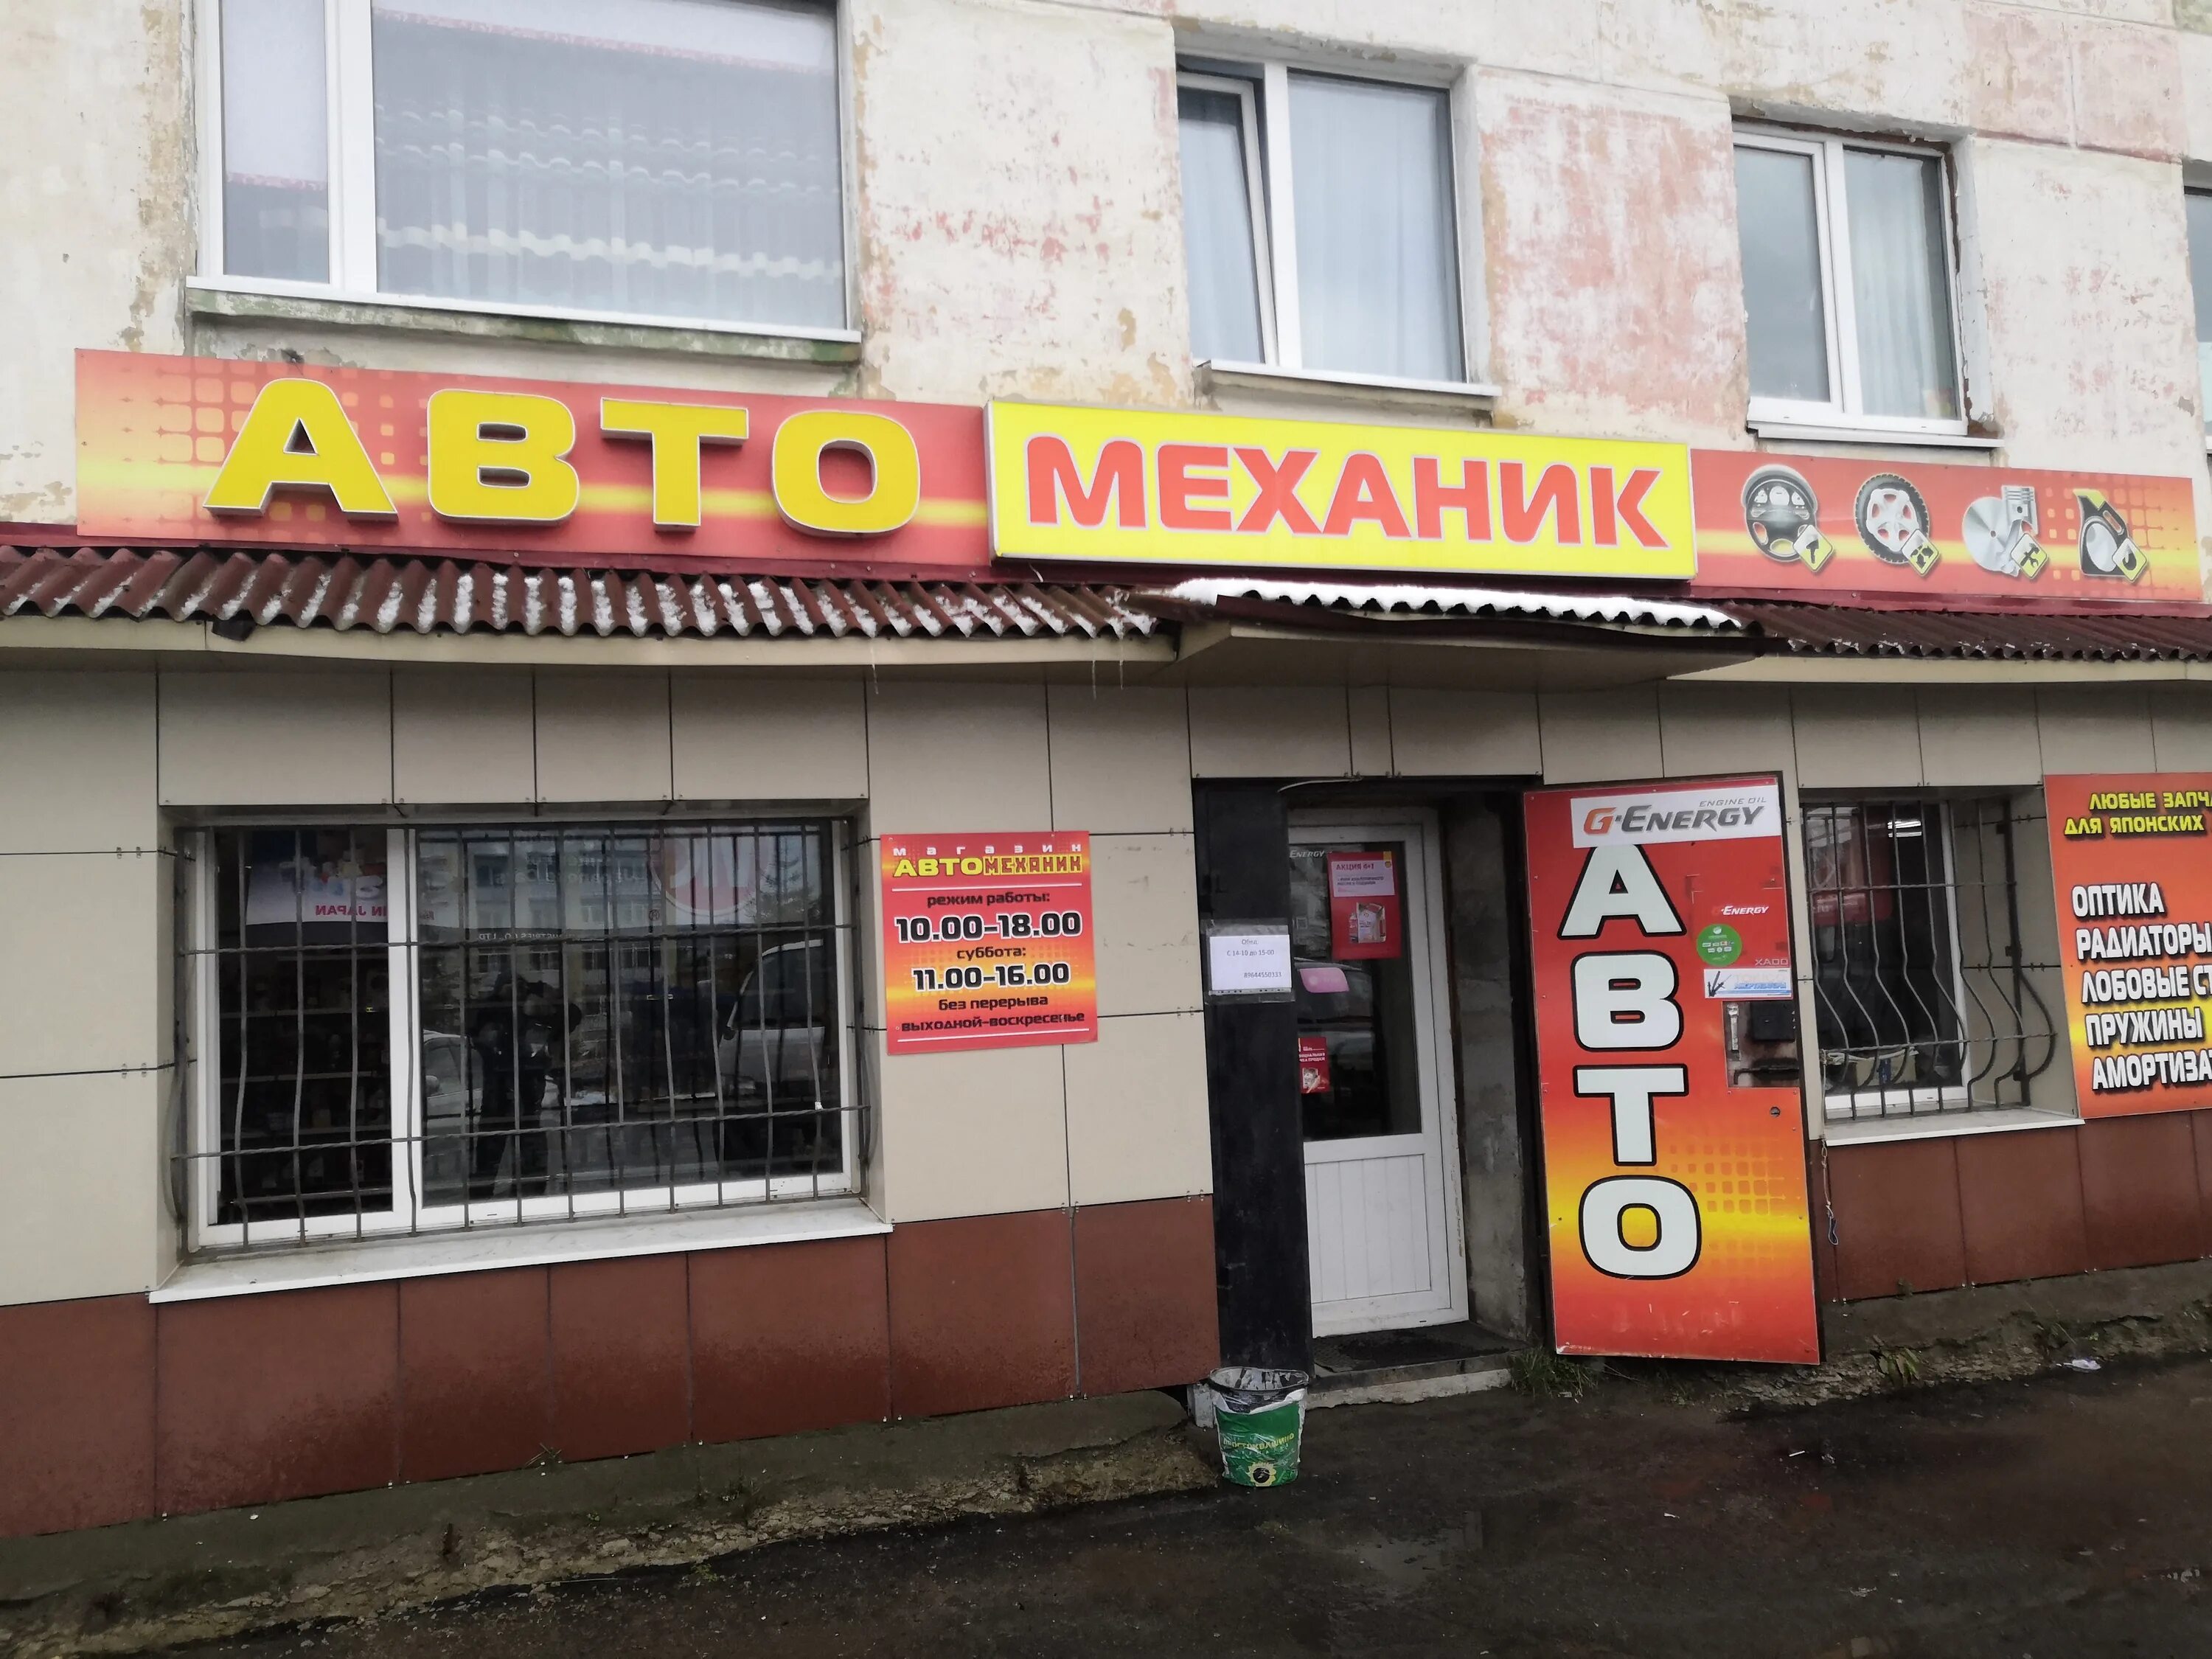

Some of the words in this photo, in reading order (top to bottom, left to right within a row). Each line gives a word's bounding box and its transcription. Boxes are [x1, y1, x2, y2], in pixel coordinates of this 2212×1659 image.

[203, 378, 920, 538] АВТО
[1026, 435, 1672, 548] МЕХАНИК
[1699, 798, 1745, 807] ENGINE
[2090, 792, 2157, 809] ЛЮБЫЕ
[2163, 790, 2212, 808] ЗАПЧ
[2065, 818, 2102, 835] ДЛЯ
[2110, 815, 2205, 833] ЯПОНСКИХ
[927, 894, 984, 908] режим
[987, 891, 1051, 906] работы:
[2072, 883, 2165, 917] ОПТИКА
[894, 911, 1082, 944] 10.00-18.00
[2076, 922, 2212, 959] РАДИАТОРЫ
[956, 947, 1026, 961] суббота:
[911, 962, 1071, 992] 11.00-16.00
[2081, 965, 2191, 1003] ЛОБОВЫЕ
[939, 998, 966, 1011] без
[970, 996, 1048, 1010] перерыва
[2085, 1007, 2203, 1046] ПРУЖИНЫ
[1557, 844, 1702, 1281] АВТО
[2093, 1049, 2212, 1090] АМОРТИЗА
